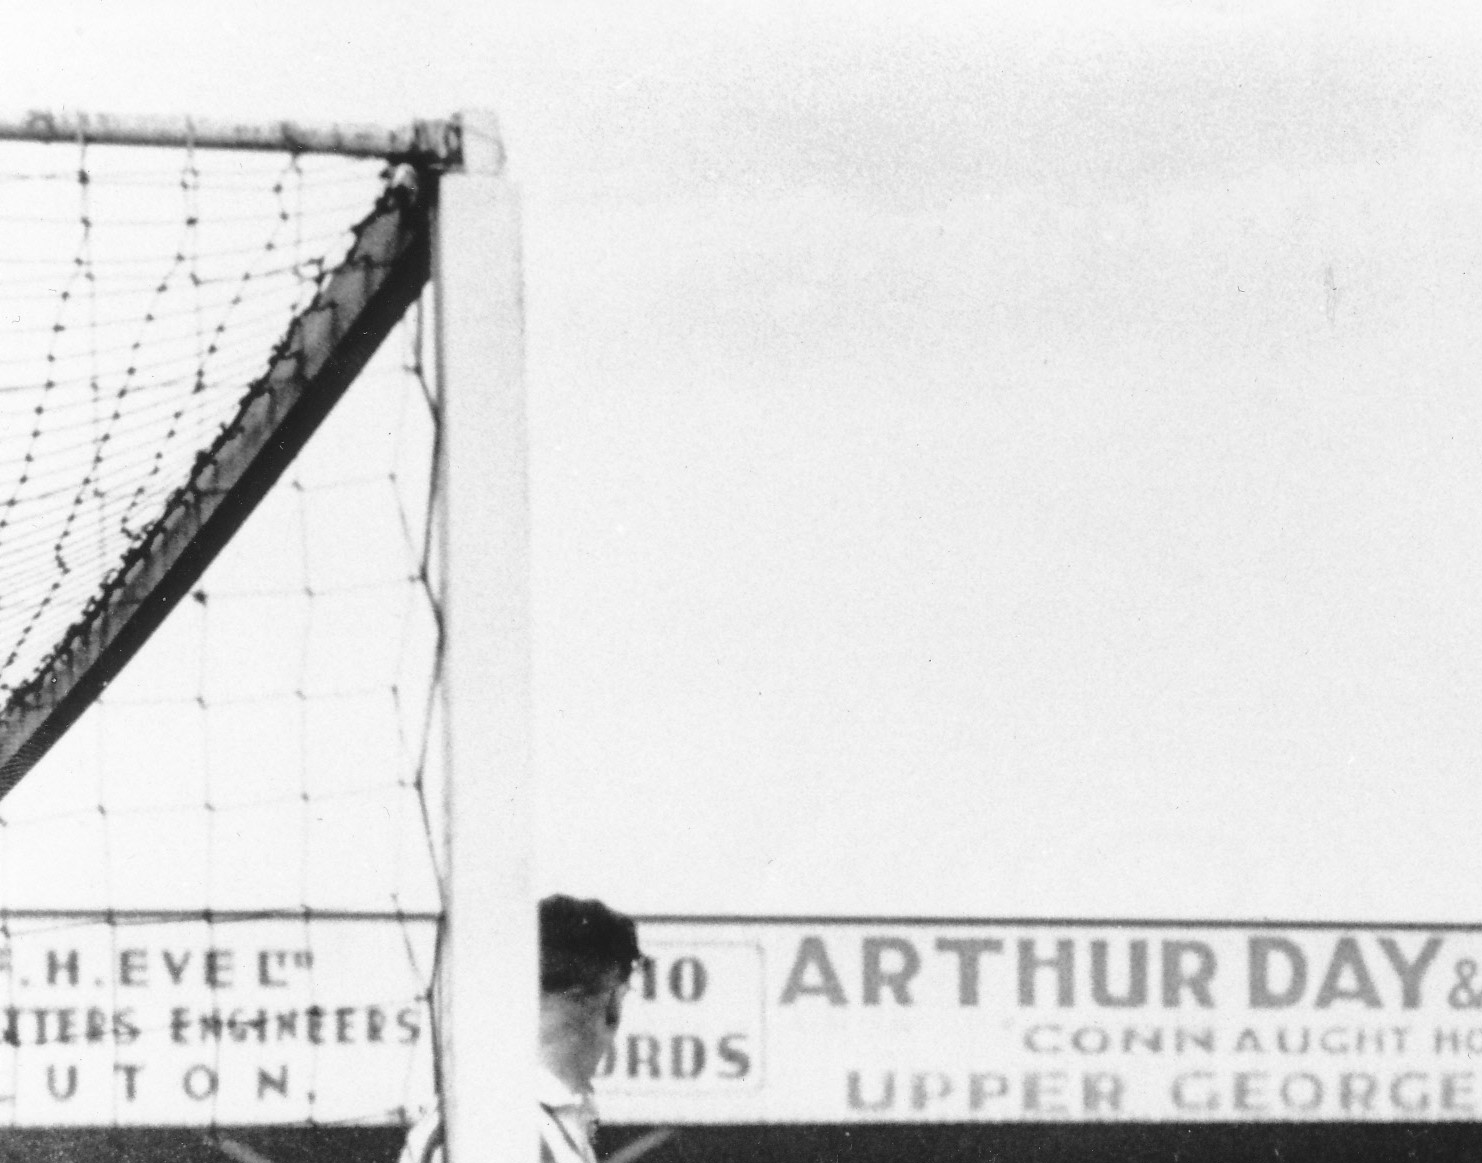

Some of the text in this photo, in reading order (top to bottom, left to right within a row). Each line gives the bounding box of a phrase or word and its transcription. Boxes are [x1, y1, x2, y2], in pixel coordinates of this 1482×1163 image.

[779, 934, 1220, 1009] ARTHUR
[1246, 935, 1446, 1010] DAY
[170, 1004, 422, 1046] ENGINEERS
[0, 1063, 316, 1102] UTON.
[845, 1069, 1126, 1114] UPPER
[1170, 1070, 1477, 1115] GEORGE
